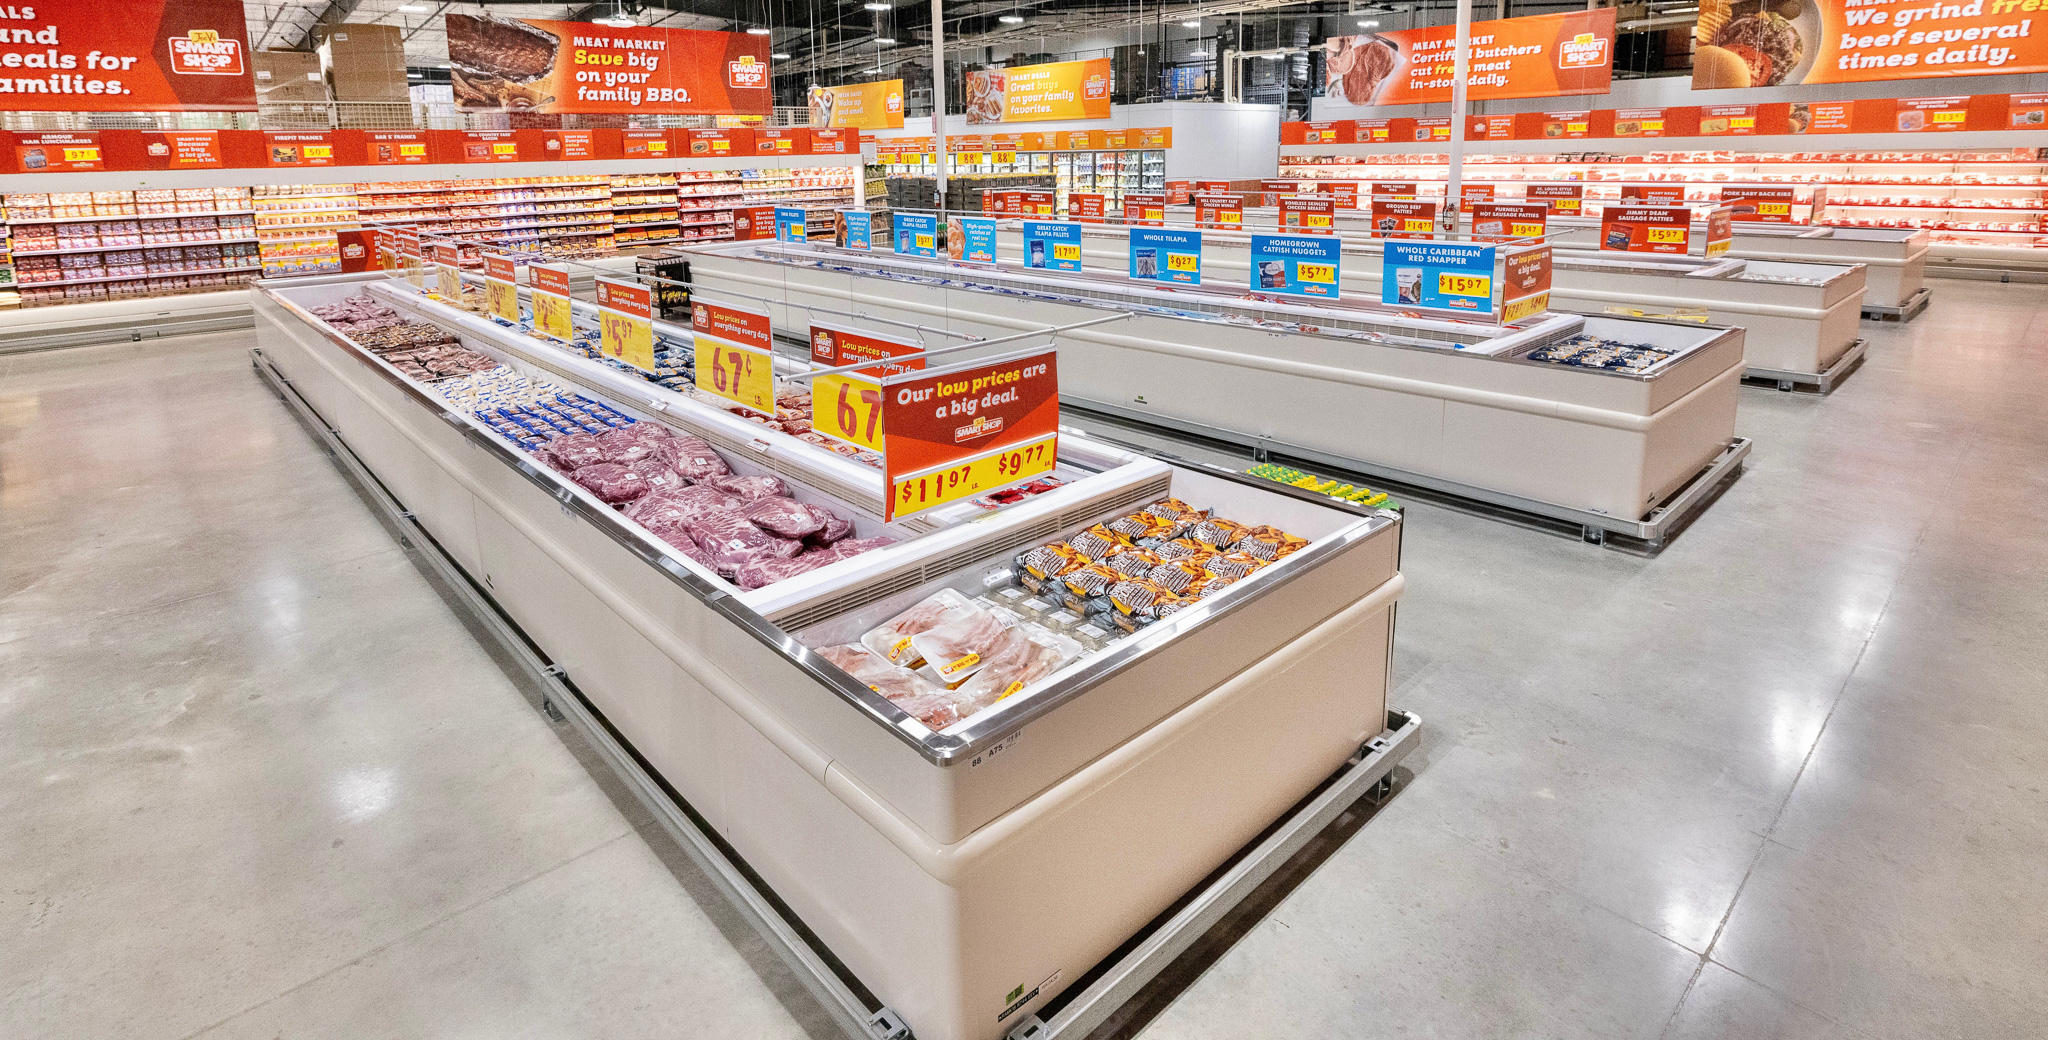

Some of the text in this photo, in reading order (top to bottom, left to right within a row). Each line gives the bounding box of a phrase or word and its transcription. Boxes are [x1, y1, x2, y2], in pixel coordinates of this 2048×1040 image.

[1845, 0, 1982, 28] We grind
[1840, 20, 2032, 50] beef several
[174, 40, 236, 55] SMART
[573, 36, 666, 50] MEAT MARKET
[1412, 35, 1494, 50] MEAT MKET
[1564, 40, 1604, 53] SMART
[0, 50, 137, 70] eals for
[183, 54, 232, 68] SHOP
[574, 50, 659, 71] Save big
[1412, 44, 1542, 64] Certifi butchers
[1566, 52, 1600, 62] SHOP
[1838, 44, 2017, 70] times daily.
[731, 64, 764, 74] SMART
[1410, 60, 1511, 76] cut meat
[0, 74, 131, 94] amilies.
[576, 70, 650, 87] on your
[735, 73, 762, 82] SHOP
[1010, 72, 1050, 82] SMART DEALS
[1410, 74, 1510, 89] in-stor daily.
[1010, 80, 1058, 92] Great buys
[1086, 80, 1106, 89] SMART
[578, 86, 692, 106] family BBQ.
[1022, 94, 1042, 105] your
[1044, 90, 1074, 102] family
[1088, 88, 1104, 96] SHOP
[1010, 106, 1052, 115] favorites.
[967, 223, 994, 231] High-quality
[1263, 246, 1327, 256] CATFISH NUGGETS
[1269, 239, 1320, 249] HOMEGROWN
[1396, 246, 1481, 258] WHOLE CARIBBEAN
[1427, 256, 1467, 265] SNAPPER
[1509, 258, 1518, 266] Our
[1528, 253, 1541, 263] prices
[1530, 262, 1541, 271] deal.
[618, 290, 629, 298] prices
[612, 296, 631, 306] everything
[631, 301, 641, 310] every
[713, 312, 724, 321] Low
[724, 314, 740, 326] prices
[714, 322, 769, 341] everything every day.
[816, 336, 832, 348] SMART
[842, 340, 856, 351] Low
[858, 345, 880, 356] prices
[817, 346, 831, 354] SHOP
[898, 363, 1047, 405] Our low prices are
[935, 388, 1018, 418] a big deal.
[838, 382, 881, 443] 67
[956, 420, 1002, 438] SMART SHOP
[988, 744, 1003, 757] A75
